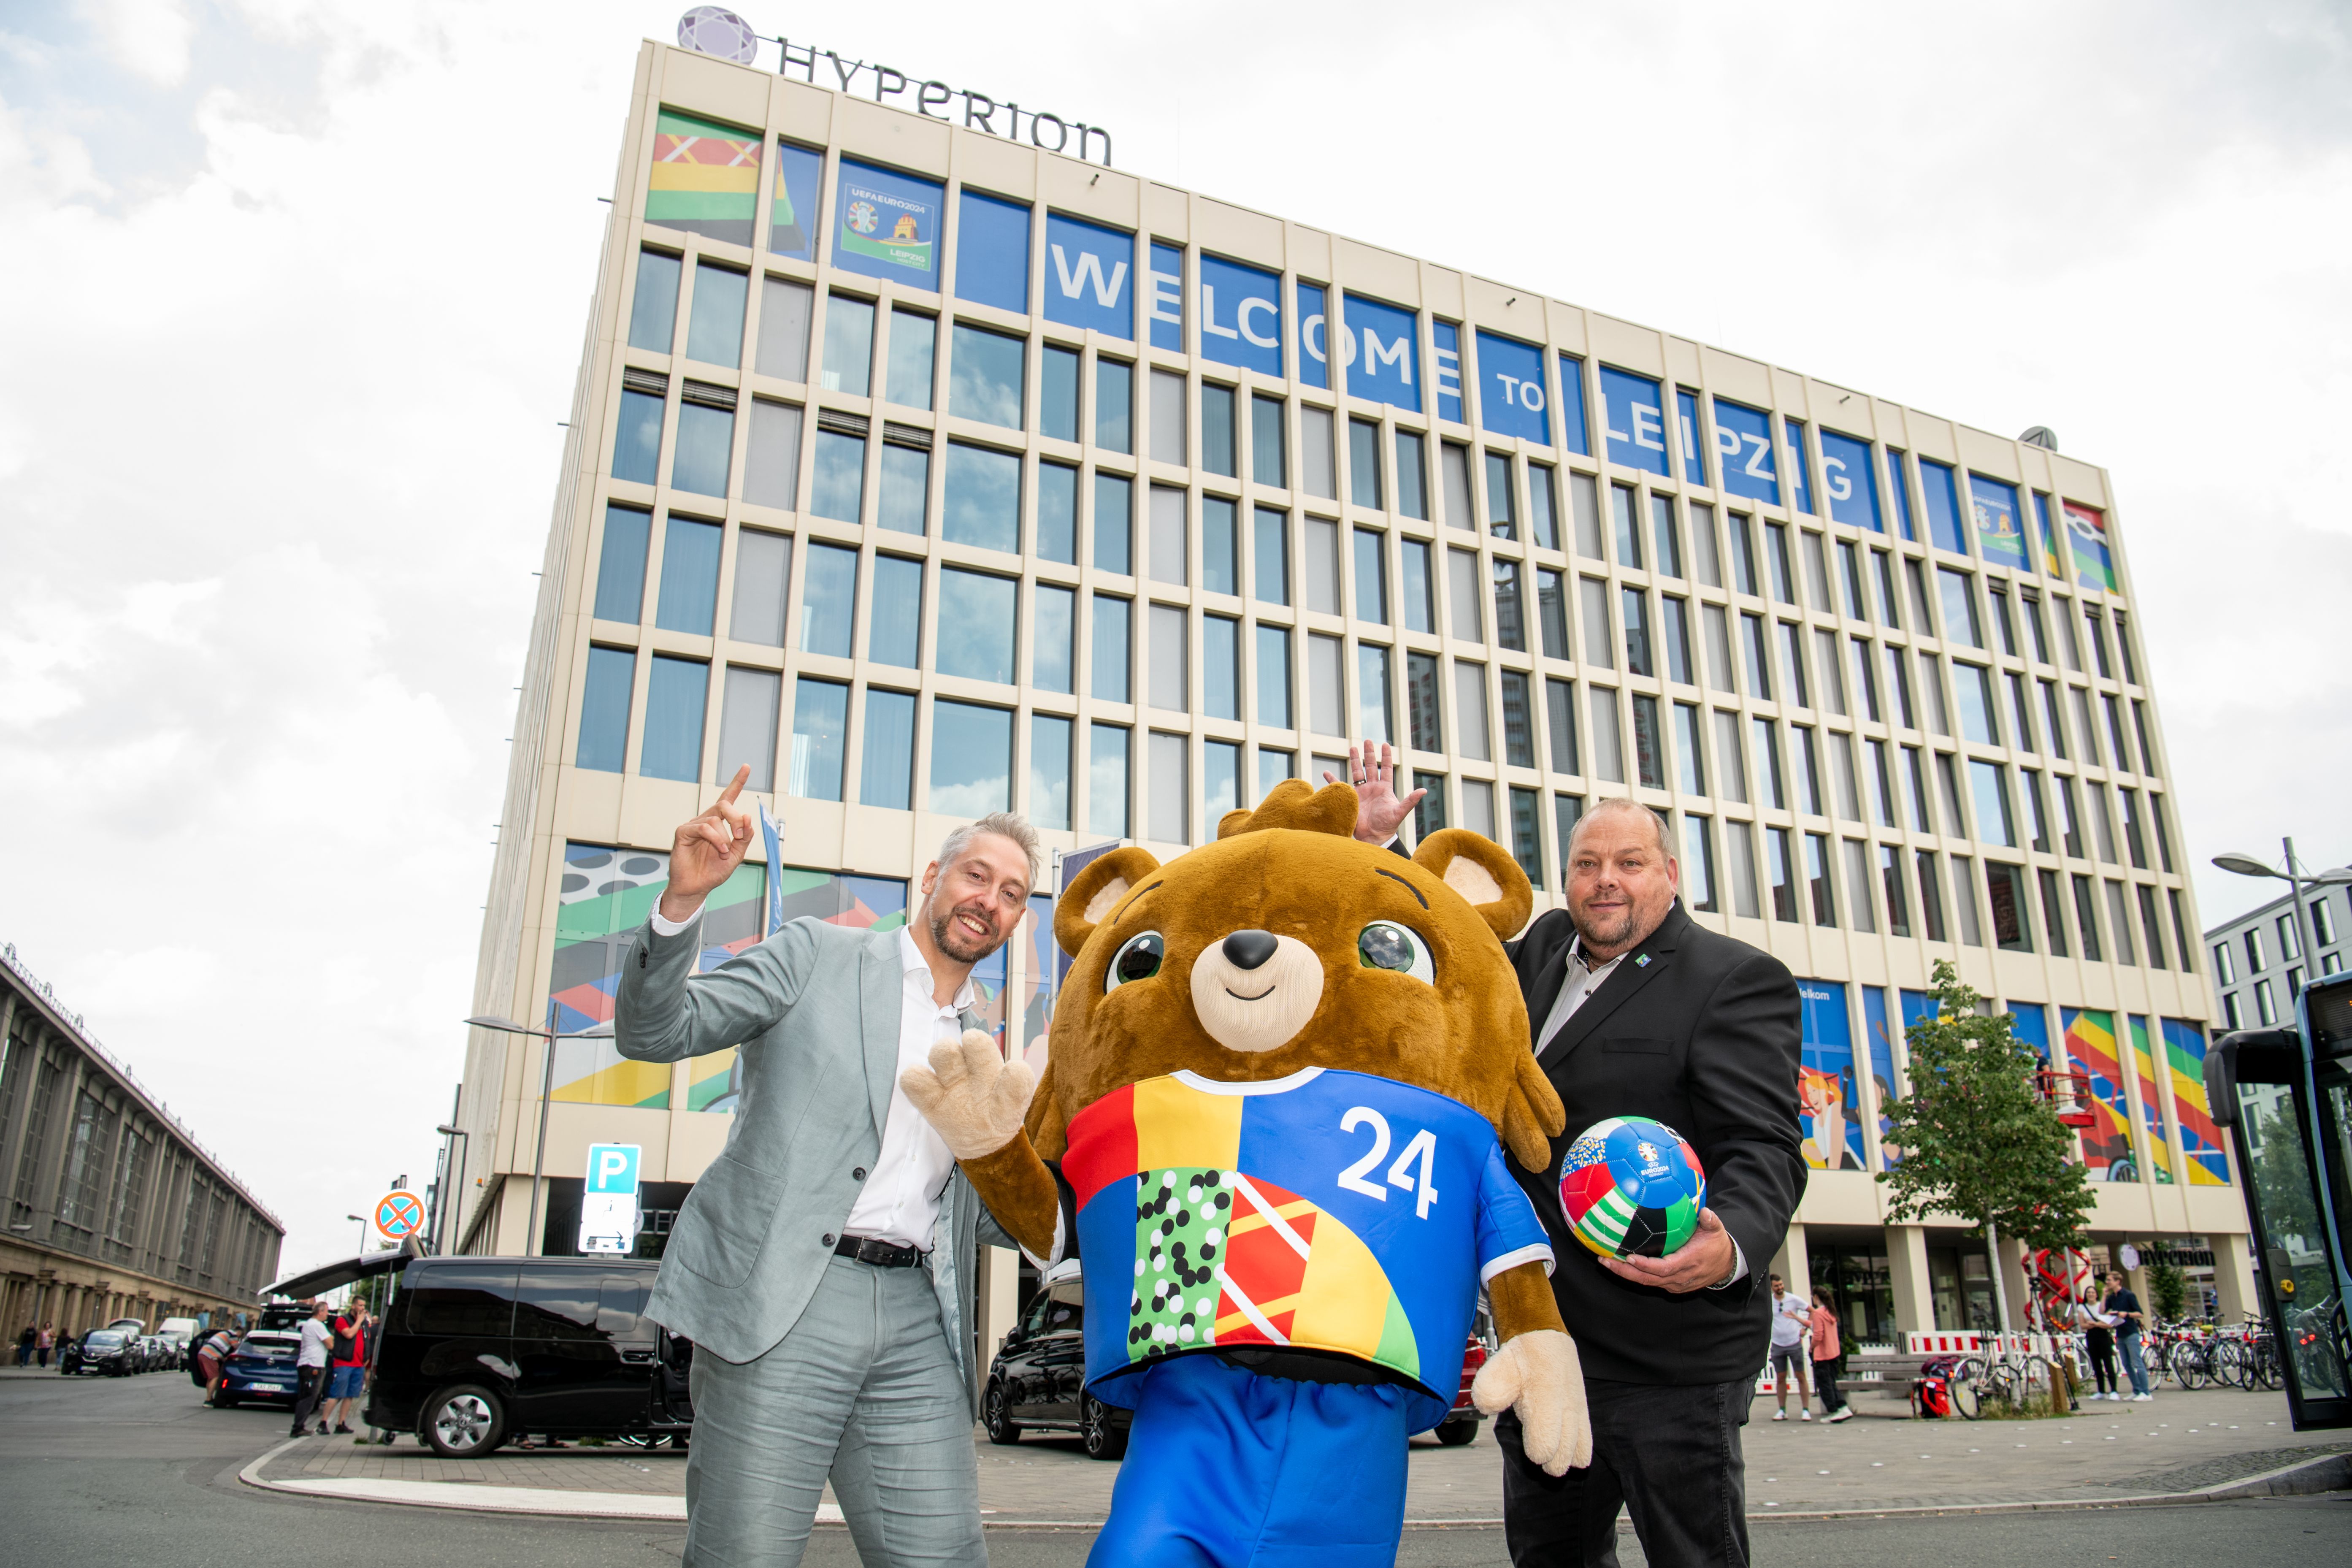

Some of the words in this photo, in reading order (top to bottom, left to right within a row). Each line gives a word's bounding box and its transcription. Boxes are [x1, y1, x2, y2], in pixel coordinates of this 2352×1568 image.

[890, 249, 926, 263] LEIPZIG
[1050, 243, 1461, 399] WELCOME
[1497, 373, 1545, 412] TO
[1604, 393, 1852, 501] LEIPZIG
[598, 1151, 628, 1189] P
[1337, 1106, 1438, 1220] 24
